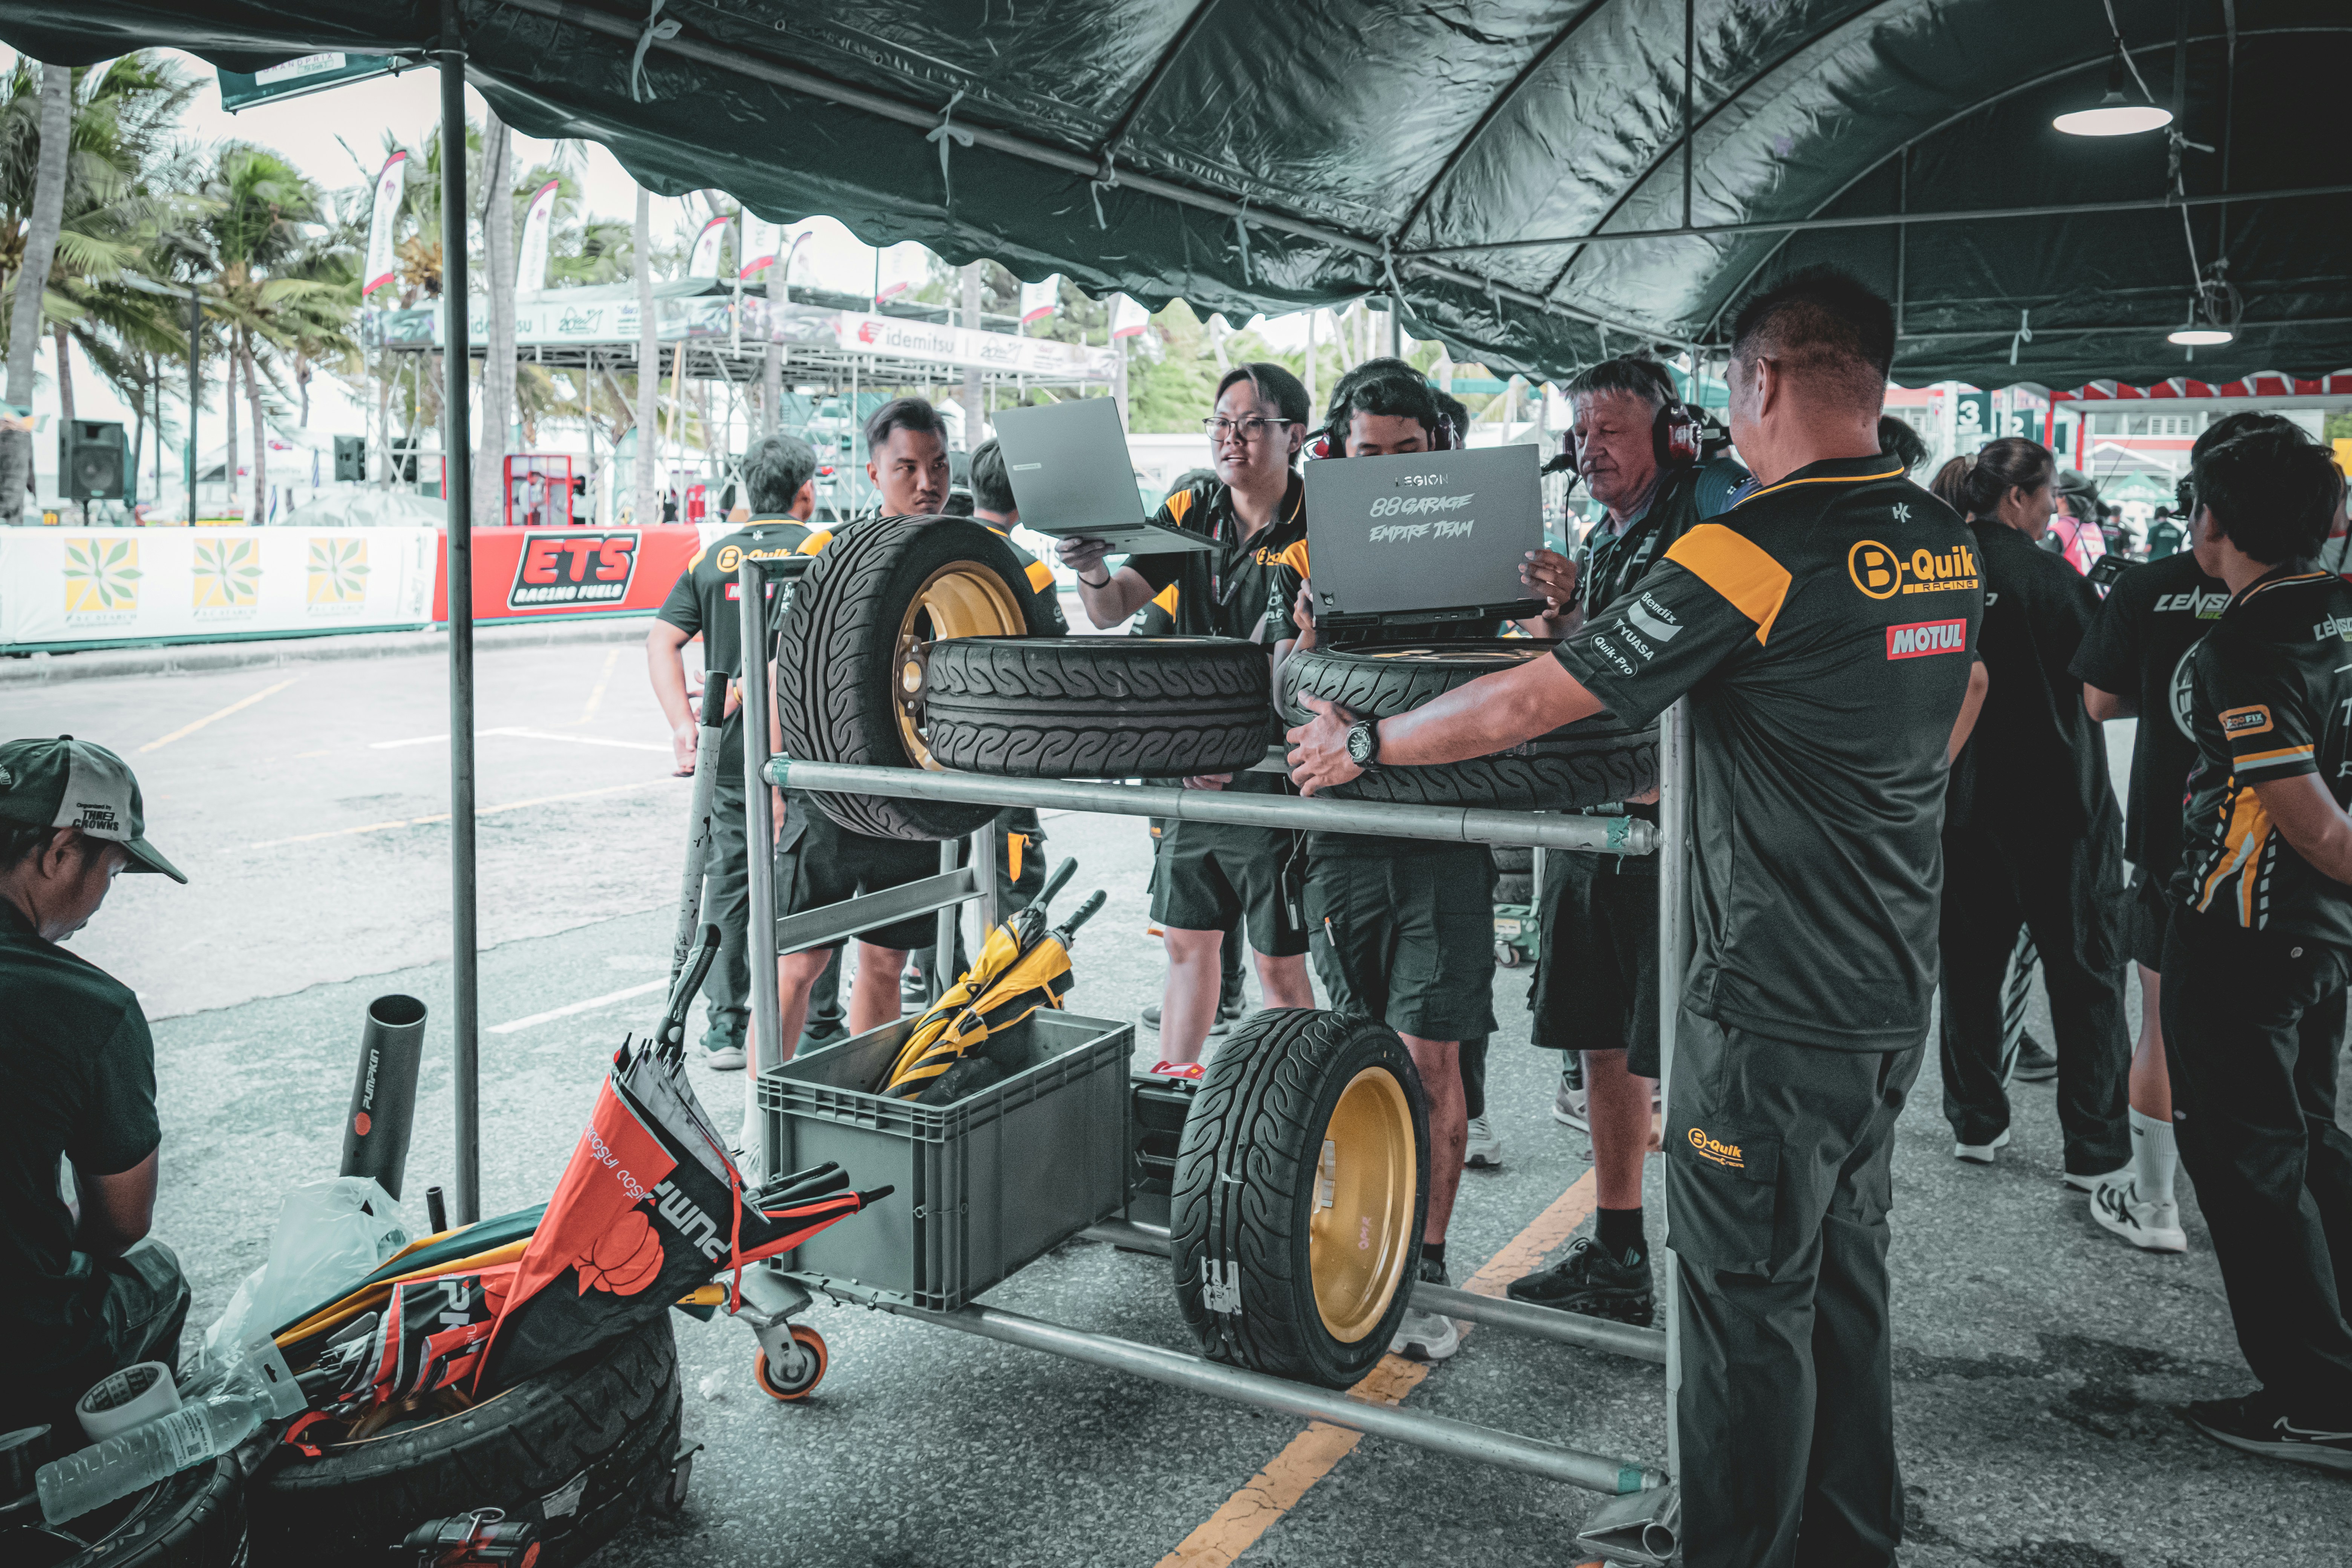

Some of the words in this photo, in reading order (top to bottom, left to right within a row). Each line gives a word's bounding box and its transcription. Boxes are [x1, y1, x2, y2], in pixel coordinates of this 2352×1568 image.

[886, 327, 954, 353] idemitsu
[1958, 400, 1980, 425] 3
[1395, 473, 1449, 487] LEGION
[1433, 519, 1475, 539] TEAM
[524, 537, 635, 583] ETS
[1848, 540, 1977, 600] B-Quik
[514, 586, 577, 603] RACING
[577, 584, 623, 599] FUELS
[1923, 580, 1974, 591] RACING
[1641, 591, 1677, 624] Bendix
[1621, 626, 1654, 660] YUASA
[1892, 624, 1962, 654] MOTUL
[1595, 637, 1633, 674] Quik-Pro
[72, 818, 119, 831] CROWNS
[355, 1048, 380, 1110] PUMPKIN
[1688, 1128, 1743, 1158] B-Quik
[616, 1169, 648, 1202] เรื่อง
